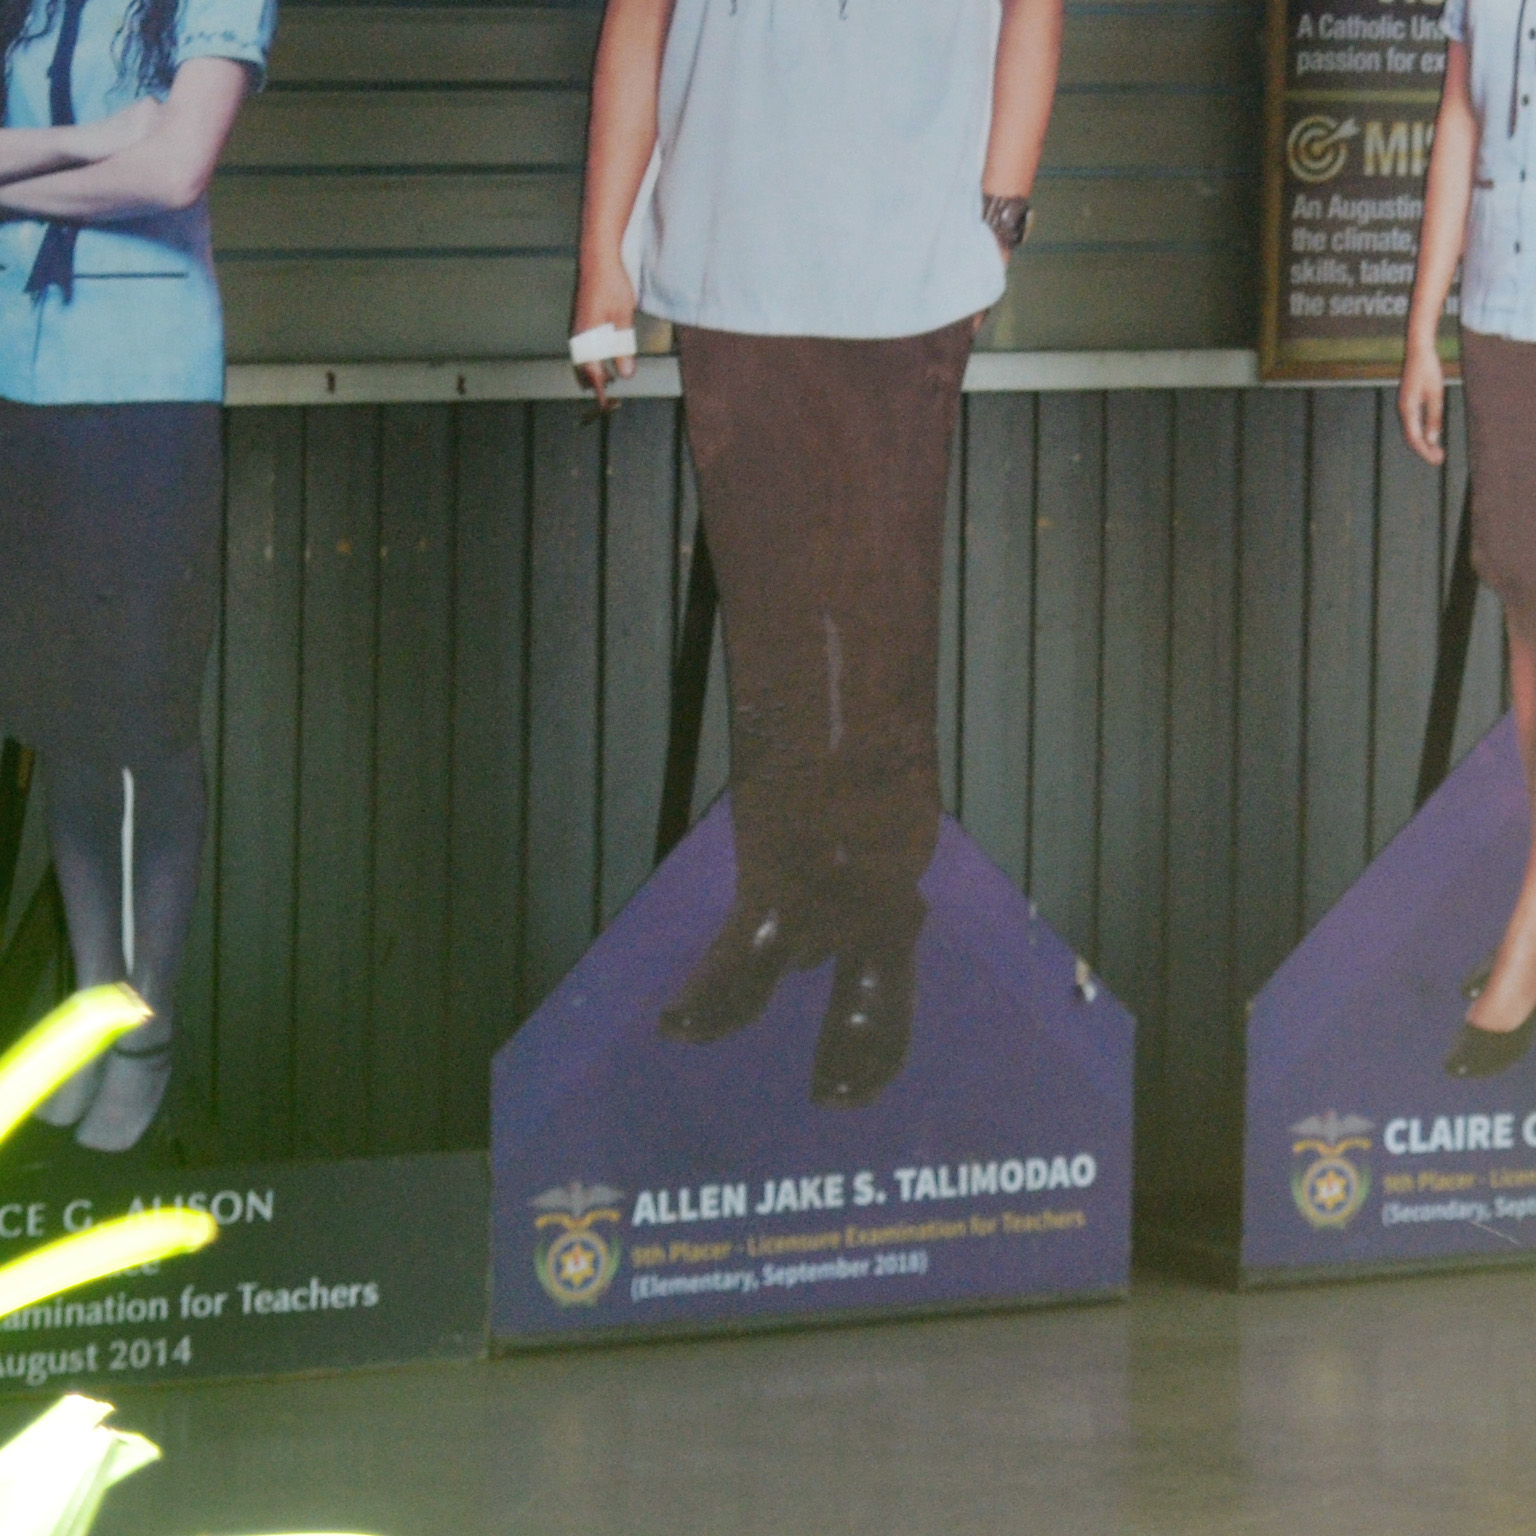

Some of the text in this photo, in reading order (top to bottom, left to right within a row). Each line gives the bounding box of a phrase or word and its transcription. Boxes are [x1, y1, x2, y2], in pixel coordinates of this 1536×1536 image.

[1318, 14, 1407, 42] Catholic
[1296, 47, 1381, 76] passion
[1386, 48, 1416, 72] for
[1328, 195, 1422, 225] Augustin
[1383, 1112, 1516, 1155] CLAIRE
[632, 1153, 1097, 1228] ALLEN JAKE S. TALIMODAO
[180, 1283, 229, 1320] for
[237, 1276, 381, 1316] Teachers
[107, 1334, 194, 1371] 2014
